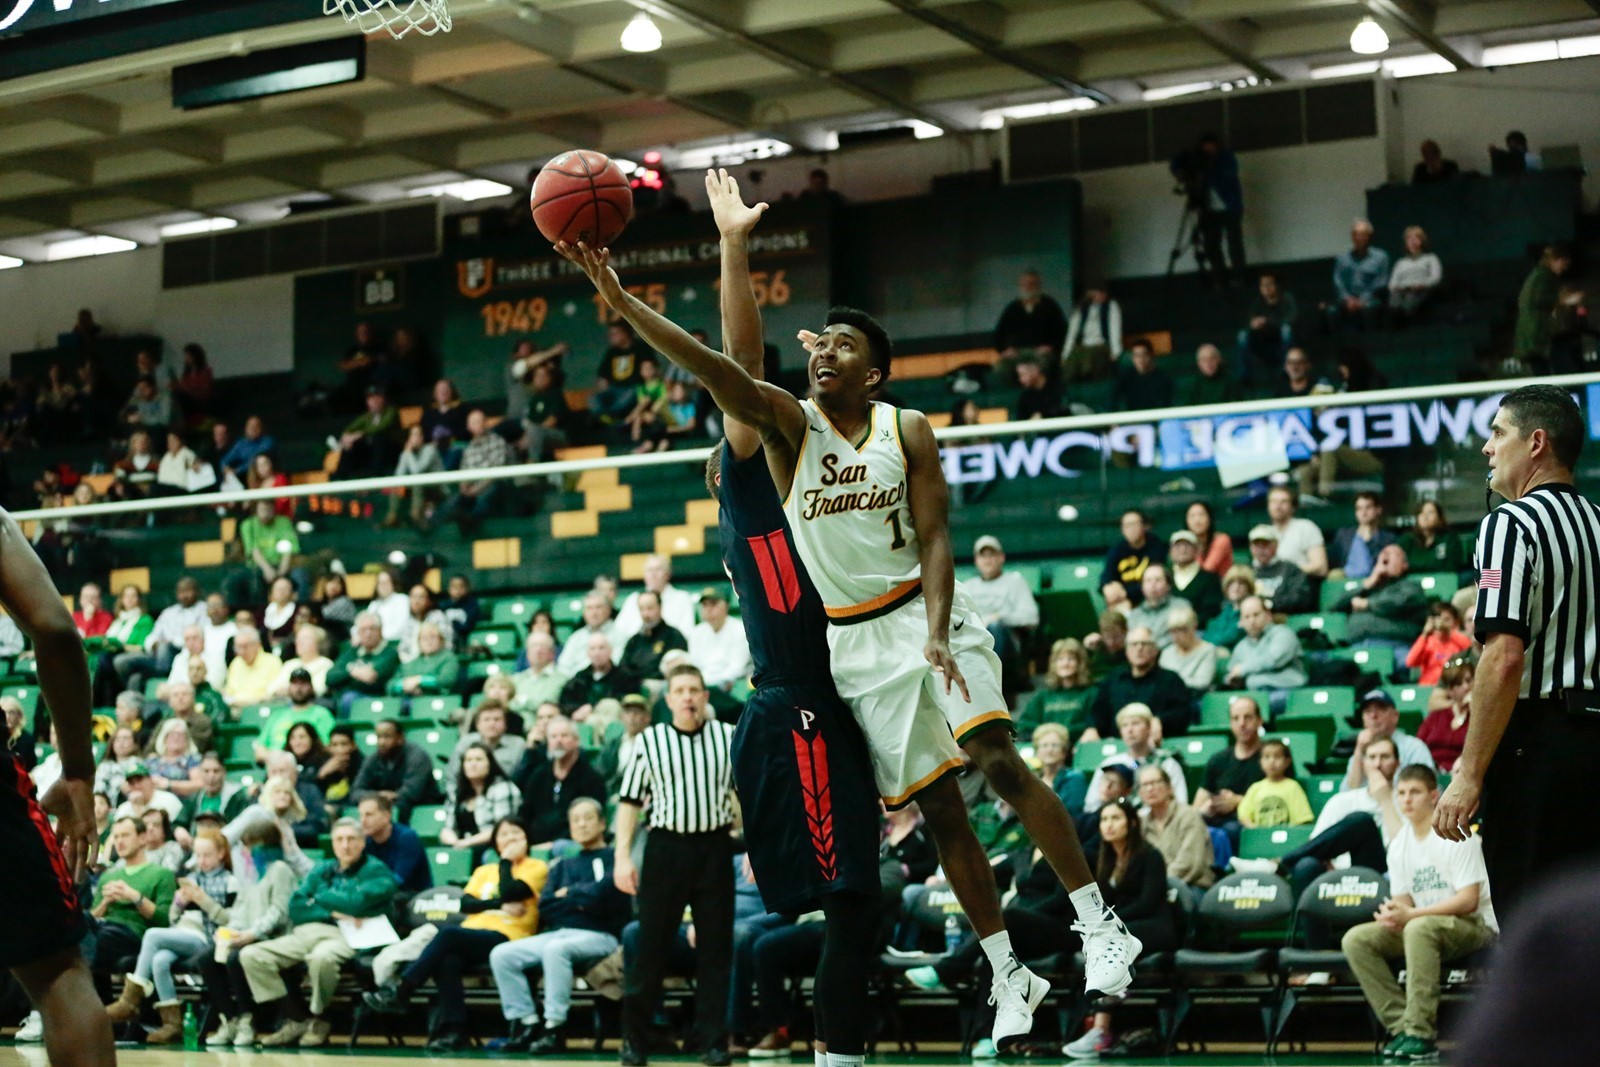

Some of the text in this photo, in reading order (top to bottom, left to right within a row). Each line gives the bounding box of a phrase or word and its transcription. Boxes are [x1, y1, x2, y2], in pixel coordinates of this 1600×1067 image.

[697, 230, 810, 260] CHPIONS
[482, 270, 790, 336] 1949 15 56
[820, 453, 867, 486] San
[803, 480, 905, 521] Francisco
[800, 709, 815, 730] P
